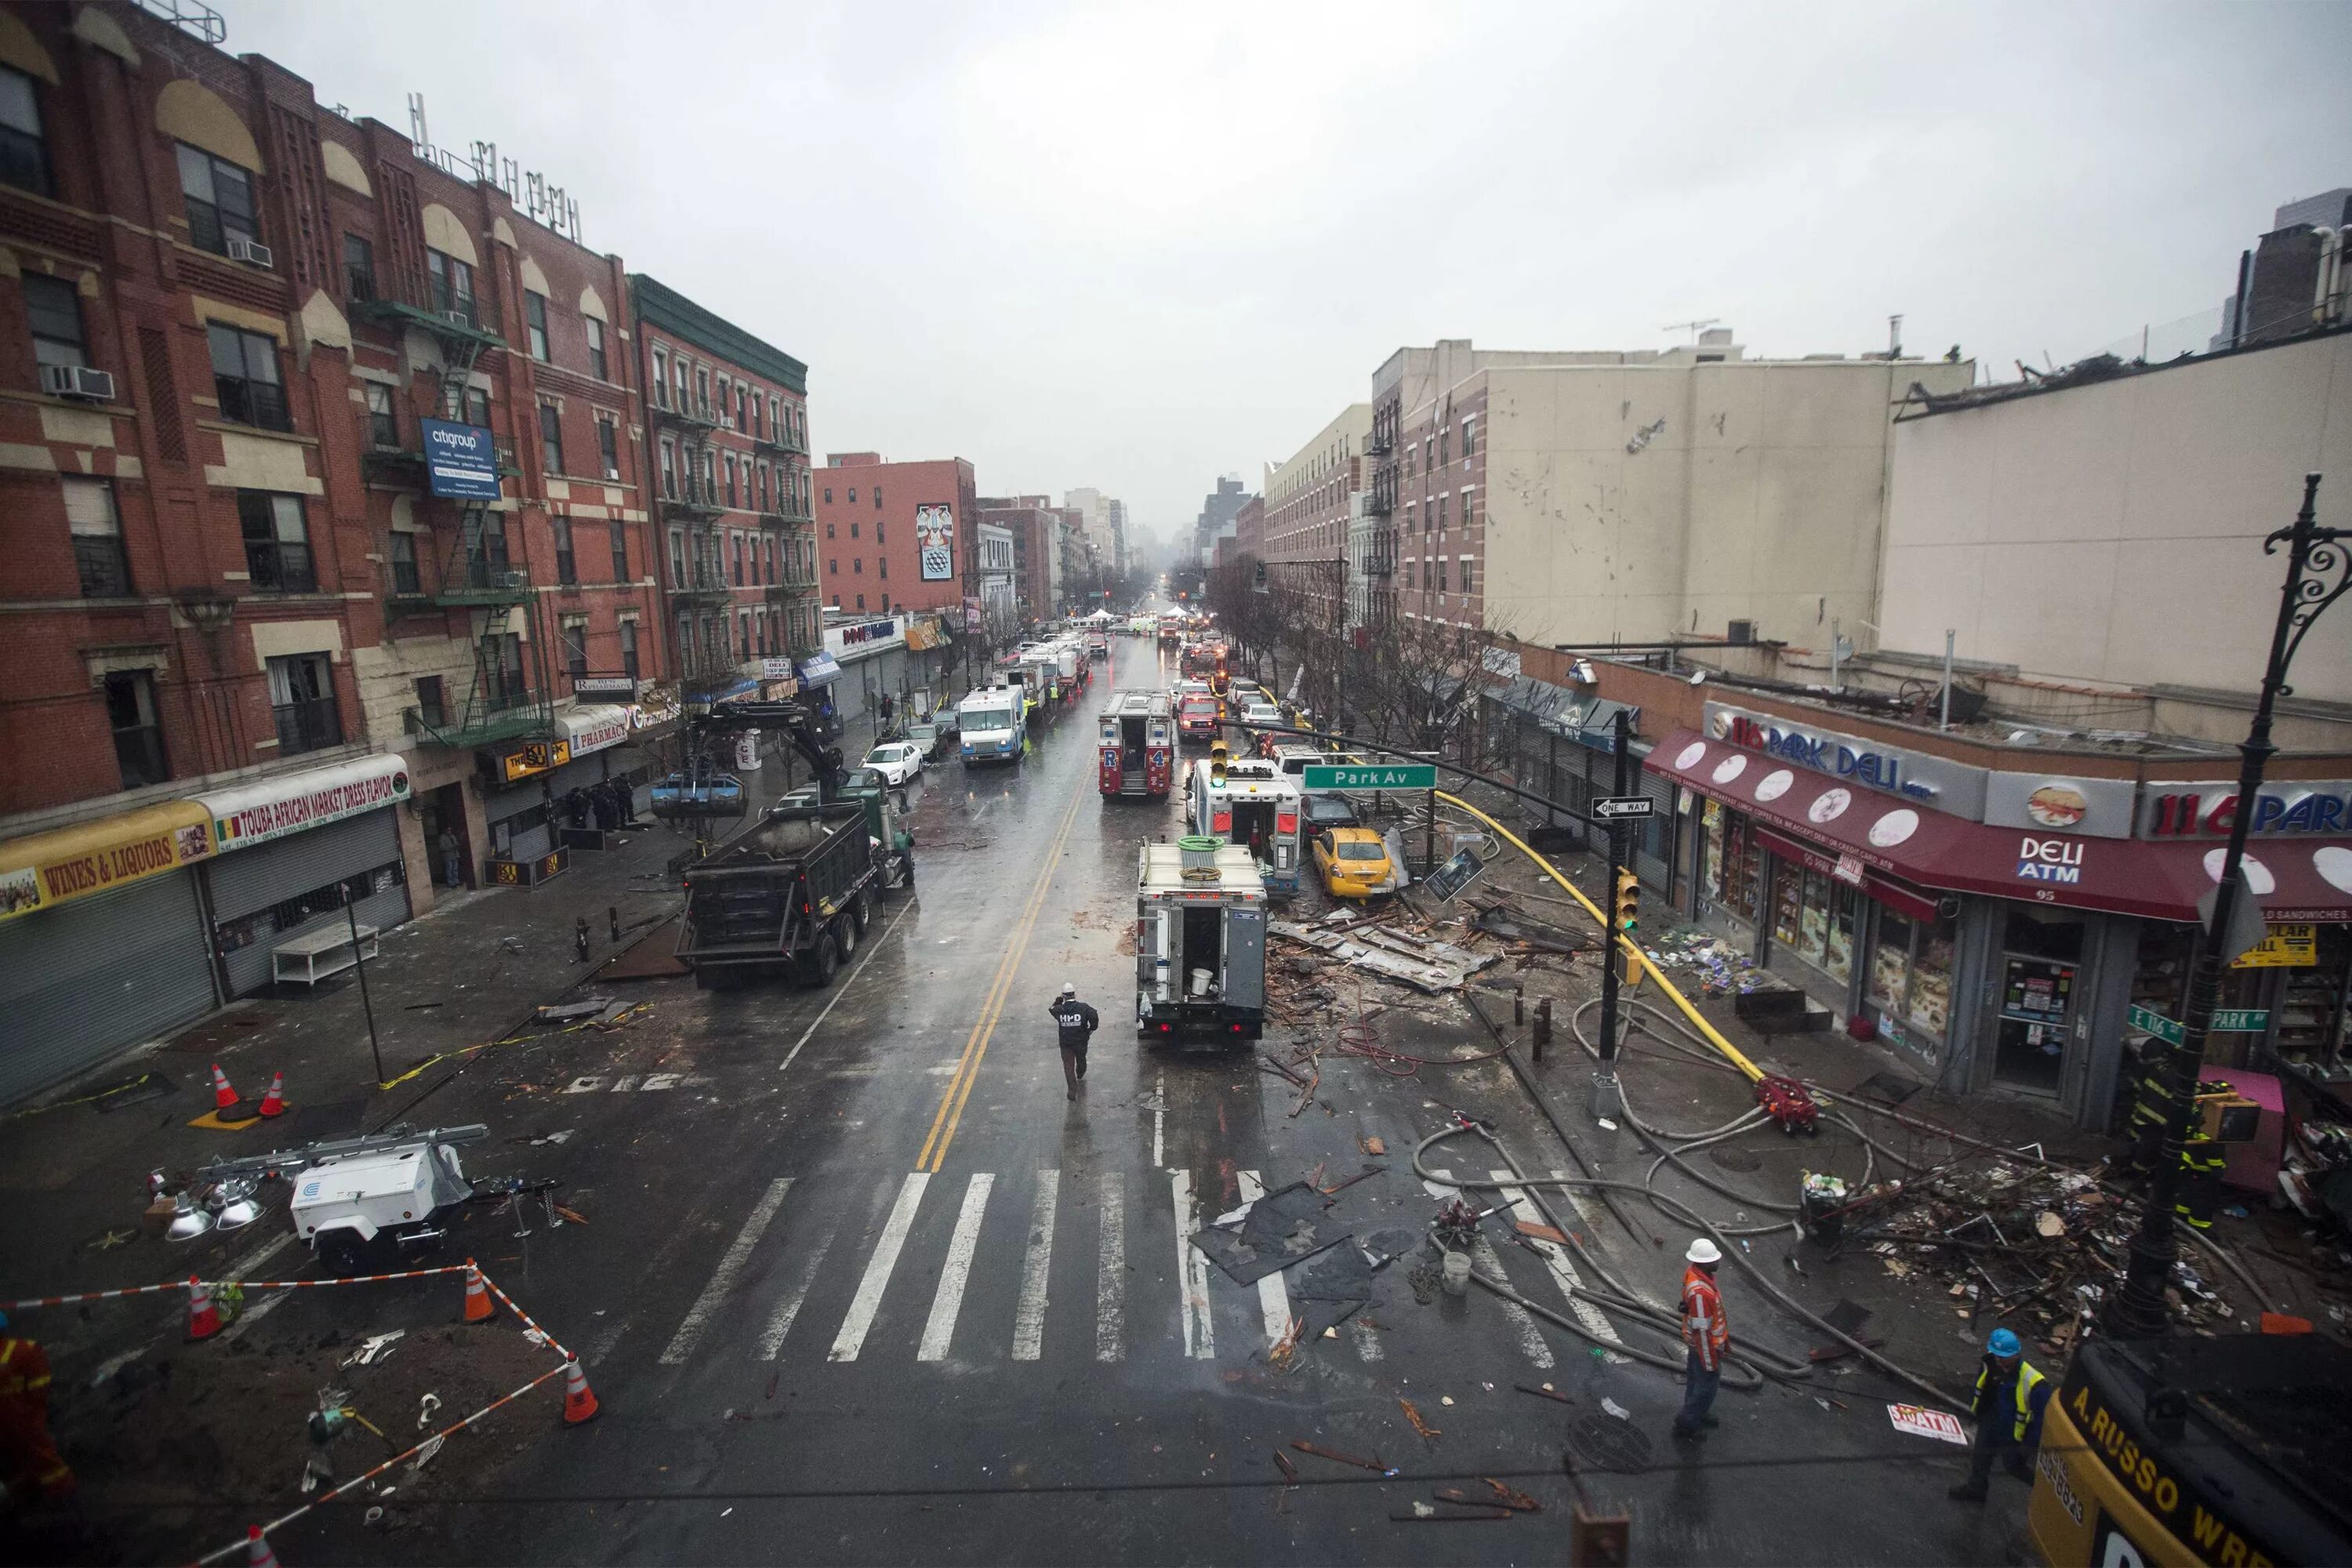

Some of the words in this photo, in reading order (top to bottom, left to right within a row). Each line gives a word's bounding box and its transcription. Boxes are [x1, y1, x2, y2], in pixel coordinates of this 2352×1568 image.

[433, 429, 476, 450] citigroup
[581, 724, 627, 748] PHARMACY
[1104, 750, 1116, 767] R
[1152, 750, 1164, 767] 4
[1733, 717, 1763, 750] 116
[1769, 728, 1828, 771] PARK
[1837, 745, 1898, 791] DELI
[1335, 771, 1378, 784] Park
[1384, 771, 1406, 784] Av
[240, 805, 274, 837] TOUBA
[274, 796, 311, 829] AFRICAN
[310, 788, 343, 819] MARKET
[343, 782, 366, 809] DRESS
[366, 775, 393, 804] FLAVOR
[1602, 804, 1620, 812] ONE
[1710, 789, 1737, 805] BREAKFAST
[1737, 800, 1754, 812] LUNCH
[1755, 806, 1773, 820] COFFEE
[2254, 793, 2352, 833] PAR
[2020, 837, 2084, 865] DELI
[43, 855, 97, 898] WINES
[99, 854, 111, 884] &
[111, 836, 172, 880] LIQUORS
[2019, 862, 2079, 883] ATM
[2036, 890, 2055, 901] 95
[2276, 910, 2347, 919] SANDWICHES
[2136, 1010, 2143, 1025] E
[2147, 1015, 2165, 1034] 116
[2211, 1012, 2249, 1029] PARK
